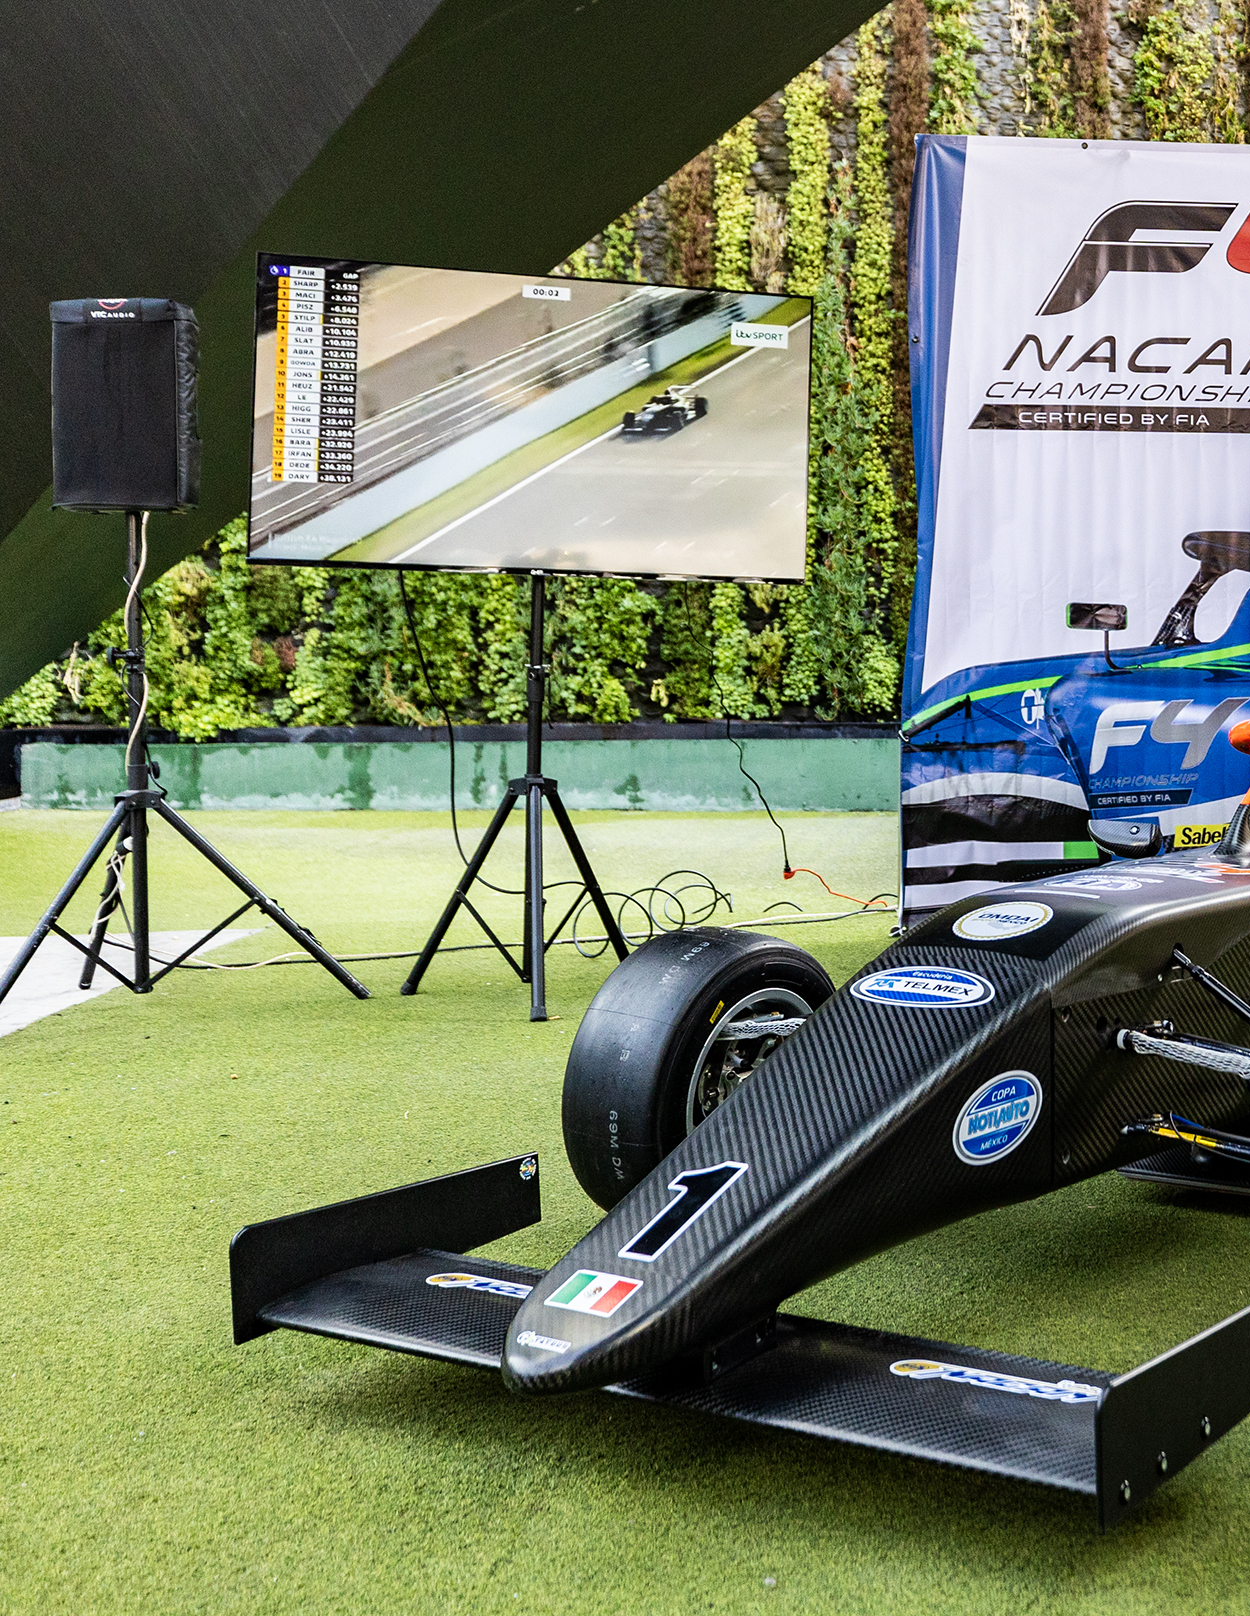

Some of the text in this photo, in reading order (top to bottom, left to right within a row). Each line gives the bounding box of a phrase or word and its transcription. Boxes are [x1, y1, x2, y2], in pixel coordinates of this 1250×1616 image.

[533, 288, 559, 297] 00:02
[753, 332, 783, 341] SPORT
[1019, 411, 1210, 427] CERTIFIED BY FIA
[1088, 773, 1199, 790] CHAMPIONSHIP
[1097, 794, 1171, 805] CERTIFIED BY FIA
[903, 980, 974, 996] TELMEX
[991, 1085, 1016, 1102] COPA
[967, 1099, 1030, 1135] NOTIAUTO
[608, 1110, 625, 1180] 69M DM
[980, 1134, 1008, 1151] MÉXICO
[617, 1160, 749, 1263] 1
